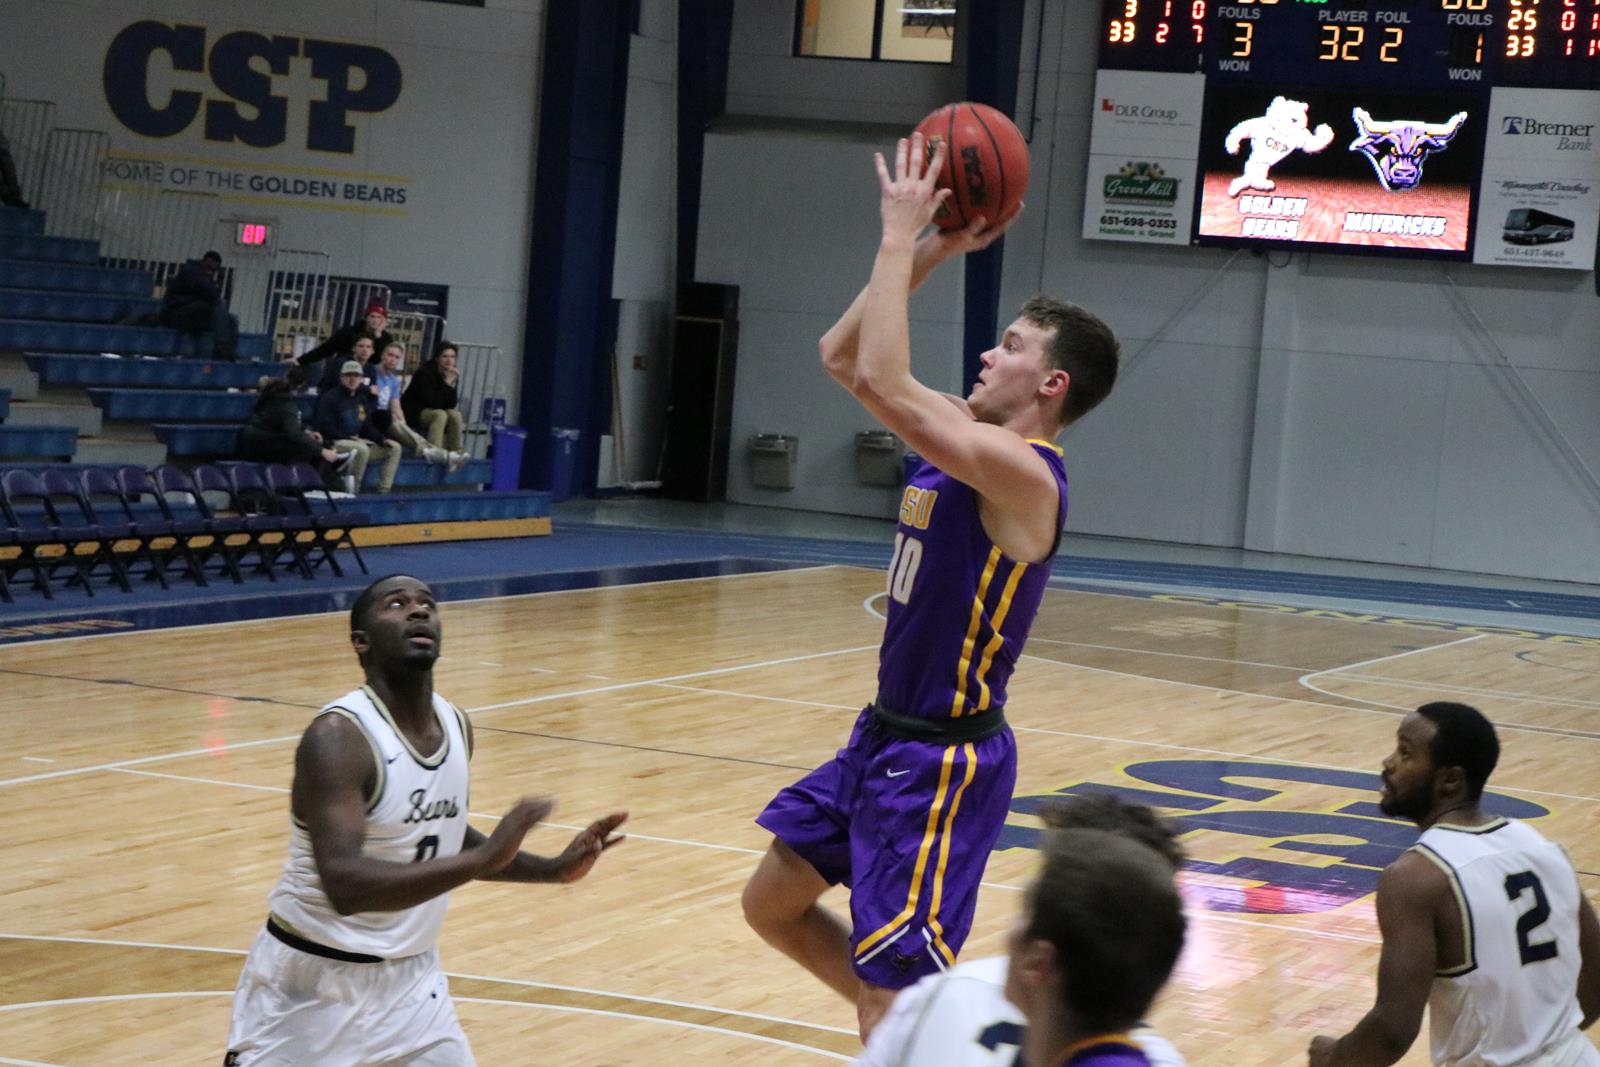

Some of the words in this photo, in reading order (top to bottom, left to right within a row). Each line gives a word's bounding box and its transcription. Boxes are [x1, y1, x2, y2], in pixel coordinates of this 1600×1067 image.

[1218, 7, 1261, 19] FOULS
[1318, 10, 1368, 22] PLAYER
[1375, 11, 1411, 24] FOUL
[1447, 13, 1493, 26] FOULS
[1507, 9, 1537, 31] 25
[1561, 10, 1576, 31] 0
[1109, 21, 1135, 42] 33
[1155, 23, 1169, 43] 2
[1192, 24, 1203, 43] 7
[1232, 22, 1253, 56] 3
[1319, 25, 1364, 60] 32
[1380, 28, 1402, 62] 2
[1475, 33, 1483, 63] 1
[1506, 35, 1535, 56] 33
[1566, 38, 1573, 56] 1
[1219, 60, 1249, 71] WON
[1448, 68, 1482, 81] WON
[102, 18, 404, 155] CSP
[1114, 104, 1138, 117] DLR
[1140, 105, 1178, 120] Group
[1524, 118, 1595, 137] Bremer
[1557, 137, 1592, 151] Bank
[169, 167, 200, 185] OF
[206, 170, 244, 190] THE
[249, 175, 336, 198] GOLDEN
[343, 183, 407, 205] BEARS
[1107, 178, 1144, 197] Green
[1144, 181, 1173, 196] Mill
[1239, 195, 1308, 216] GOLDEN
[1100, 216, 1177, 229] 651-698-0353
[1242, 217, 1300, 238] BEARS
[1343, 211, 1447, 236] MAVERICKS
[404, 789, 459, 823] Bears
[1504, 870, 1559, 966] 2
